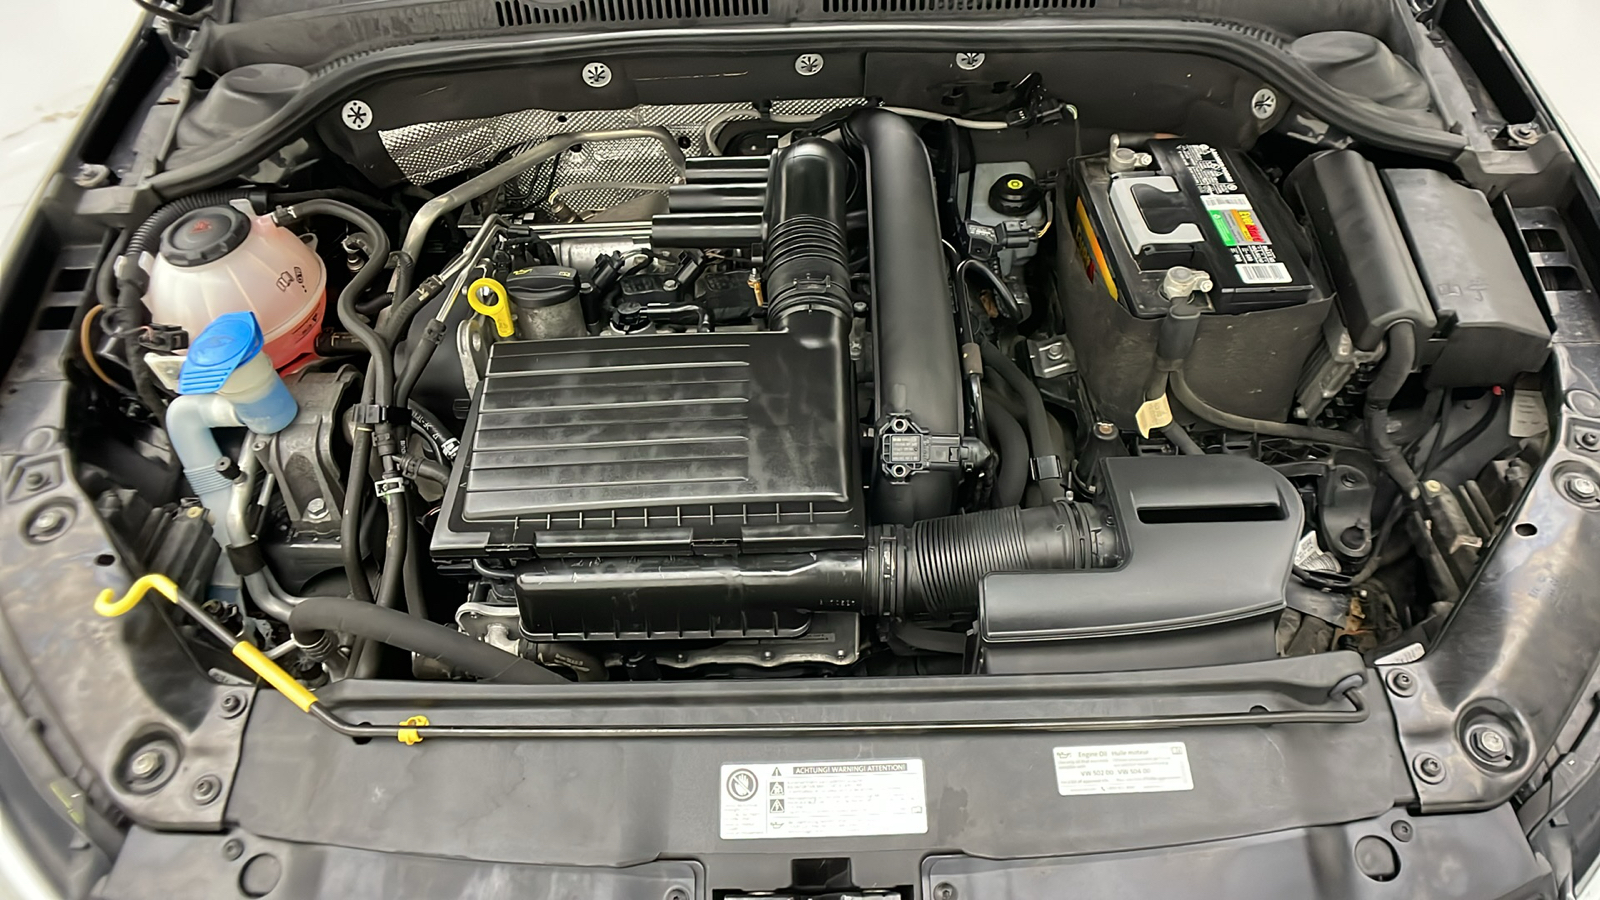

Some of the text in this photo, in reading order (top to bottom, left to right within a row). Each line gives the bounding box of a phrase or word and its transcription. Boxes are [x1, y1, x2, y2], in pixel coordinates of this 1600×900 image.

[1078, 751, 1098, 759] Engine
[795, 764, 906, 774] ACHTUNG! WARNING! ATTENTION!
